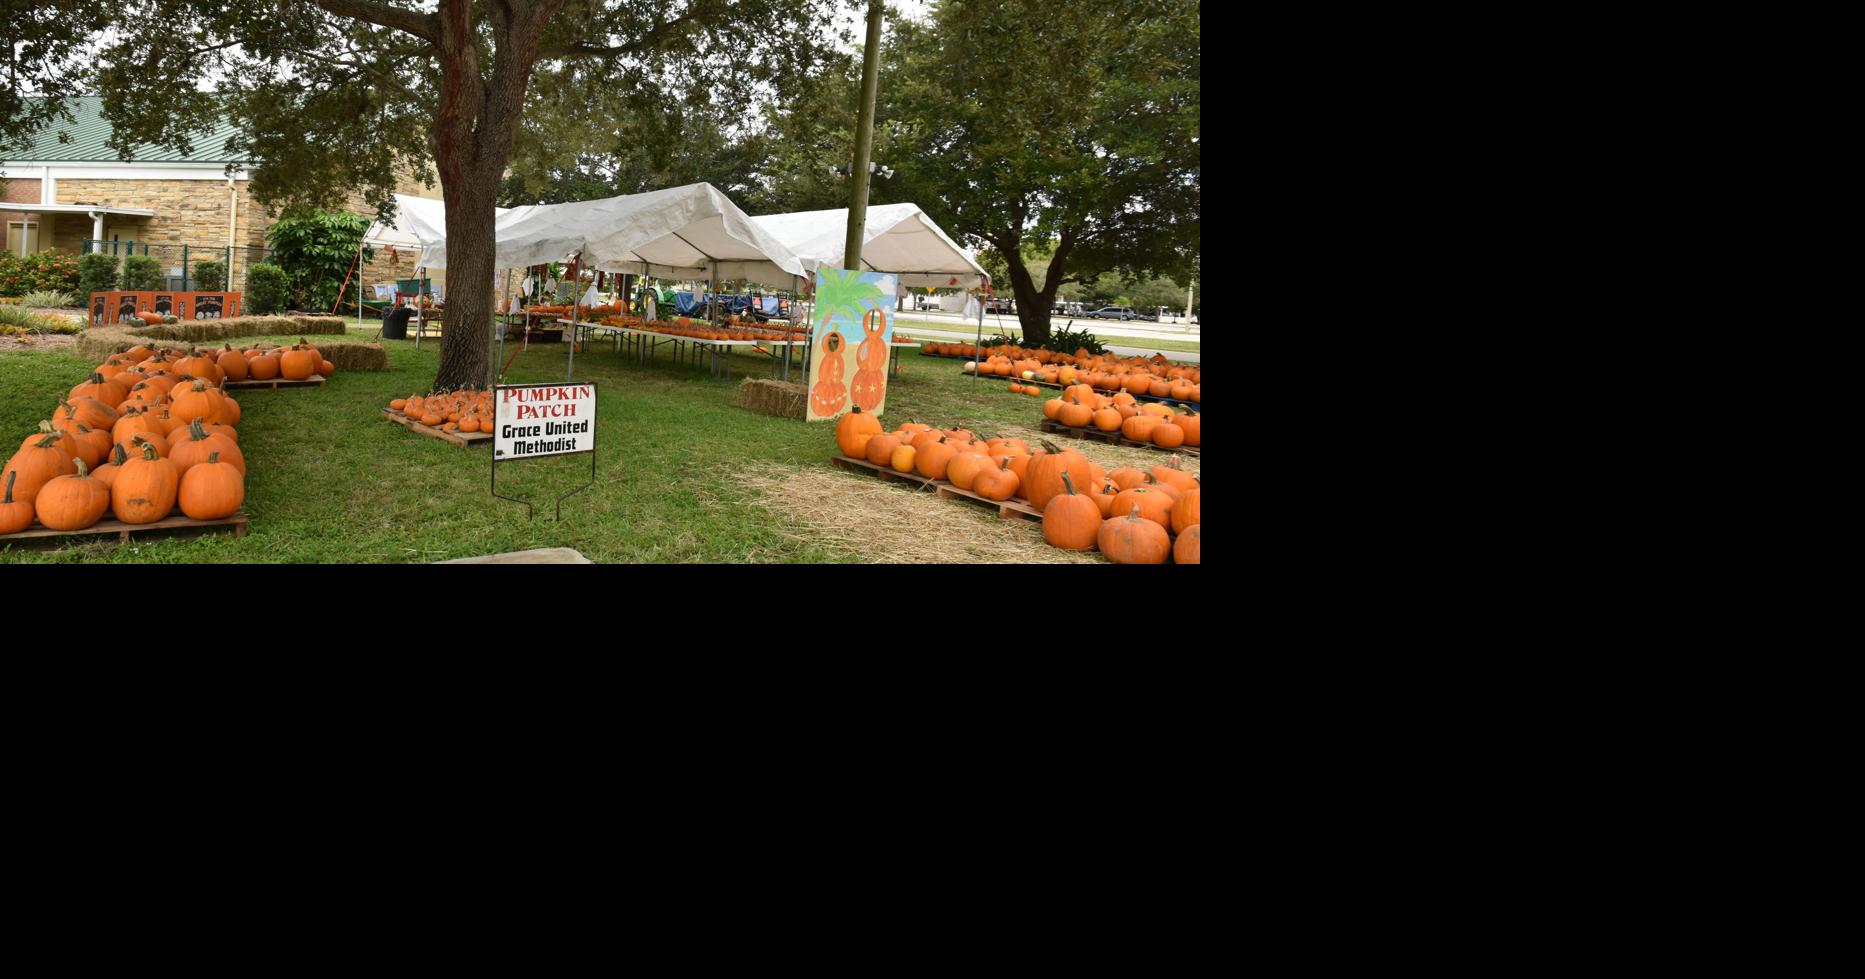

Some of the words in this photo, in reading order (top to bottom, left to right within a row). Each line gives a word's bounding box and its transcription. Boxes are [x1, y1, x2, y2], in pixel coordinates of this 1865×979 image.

[503, 386, 590, 403] PUMPKIN
[517, 403, 576, 420] PATCH
[502, 424, 541, 438] Grace
[545, 420, 588, 435] United
[513, 438, 576, 455] Methodist
